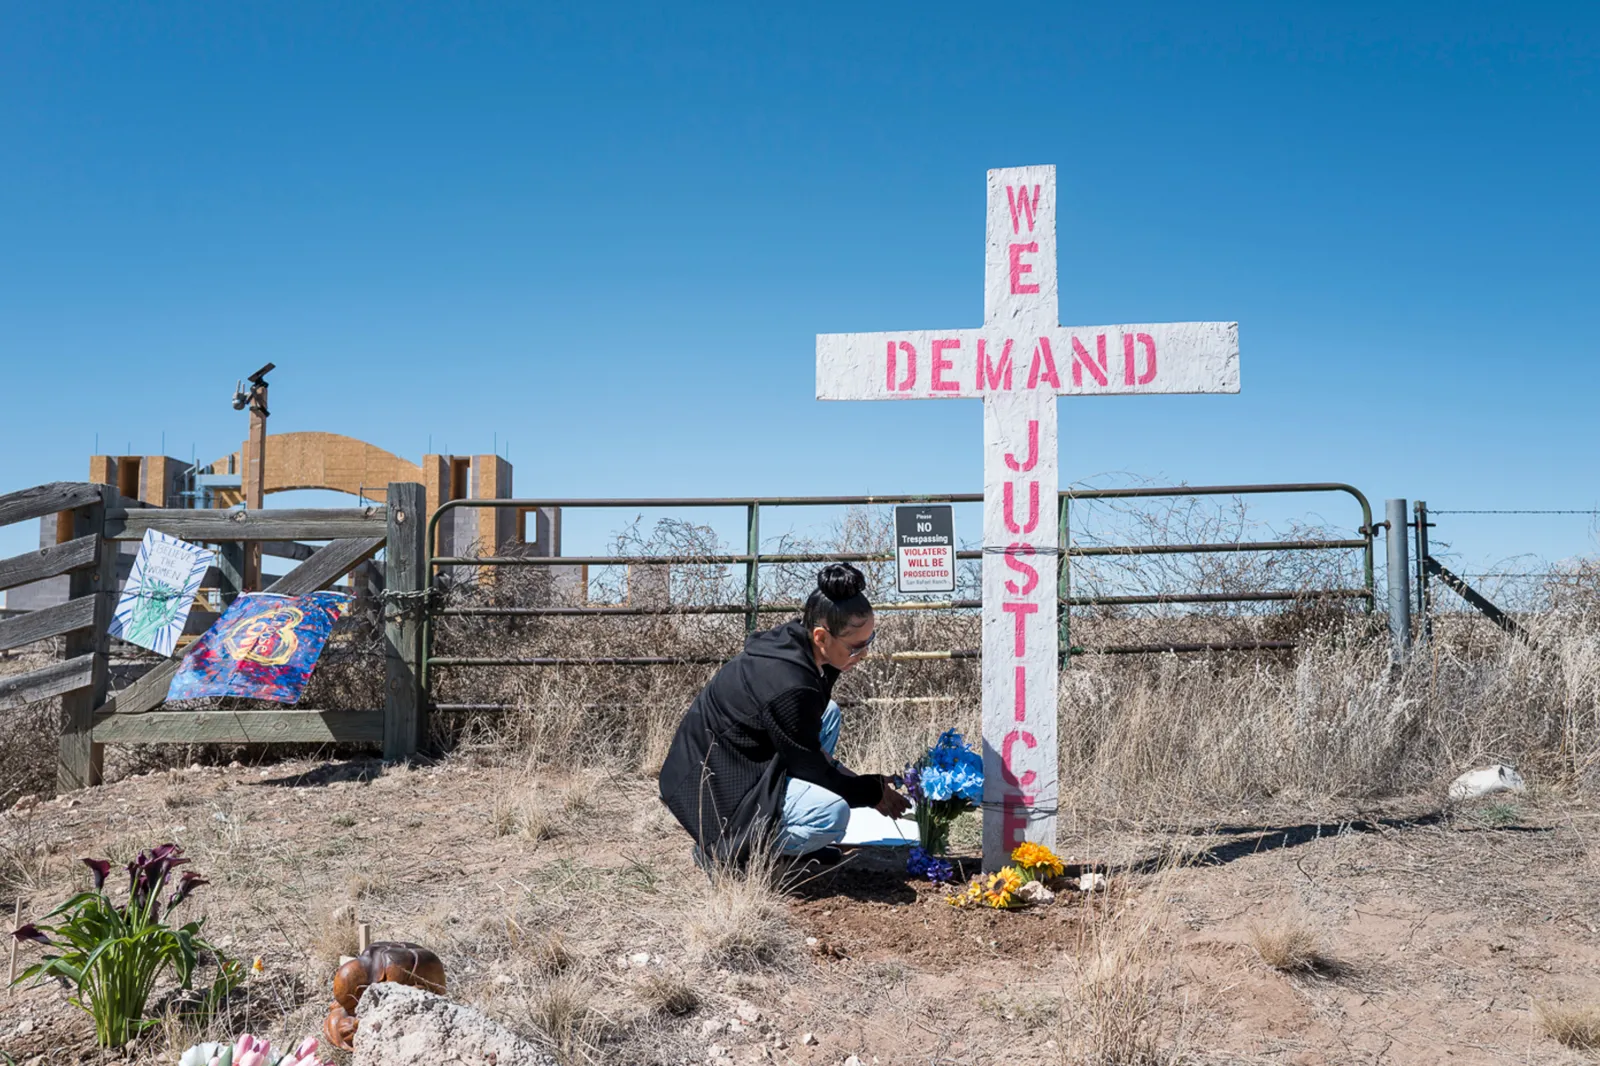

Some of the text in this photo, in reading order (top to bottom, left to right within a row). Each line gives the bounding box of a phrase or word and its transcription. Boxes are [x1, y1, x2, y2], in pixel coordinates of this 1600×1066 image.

[1005, 184, 1041, 296] WE
[886, 332, 1158, 391] DEMAND
[917, 522, 932, 532] NO
[902, 534, 948, 544] Trespassing
[156, 543, 192, 562] BELIEVE
[904, 548, 947, 556] VIOLATERS
[160, 556, 177, 569] THE
[908, 558, 944, 567] WILL BE
[148, 565, 182, 581] WOMEN
[1002, 420, 1041, 853] JUSTICE
